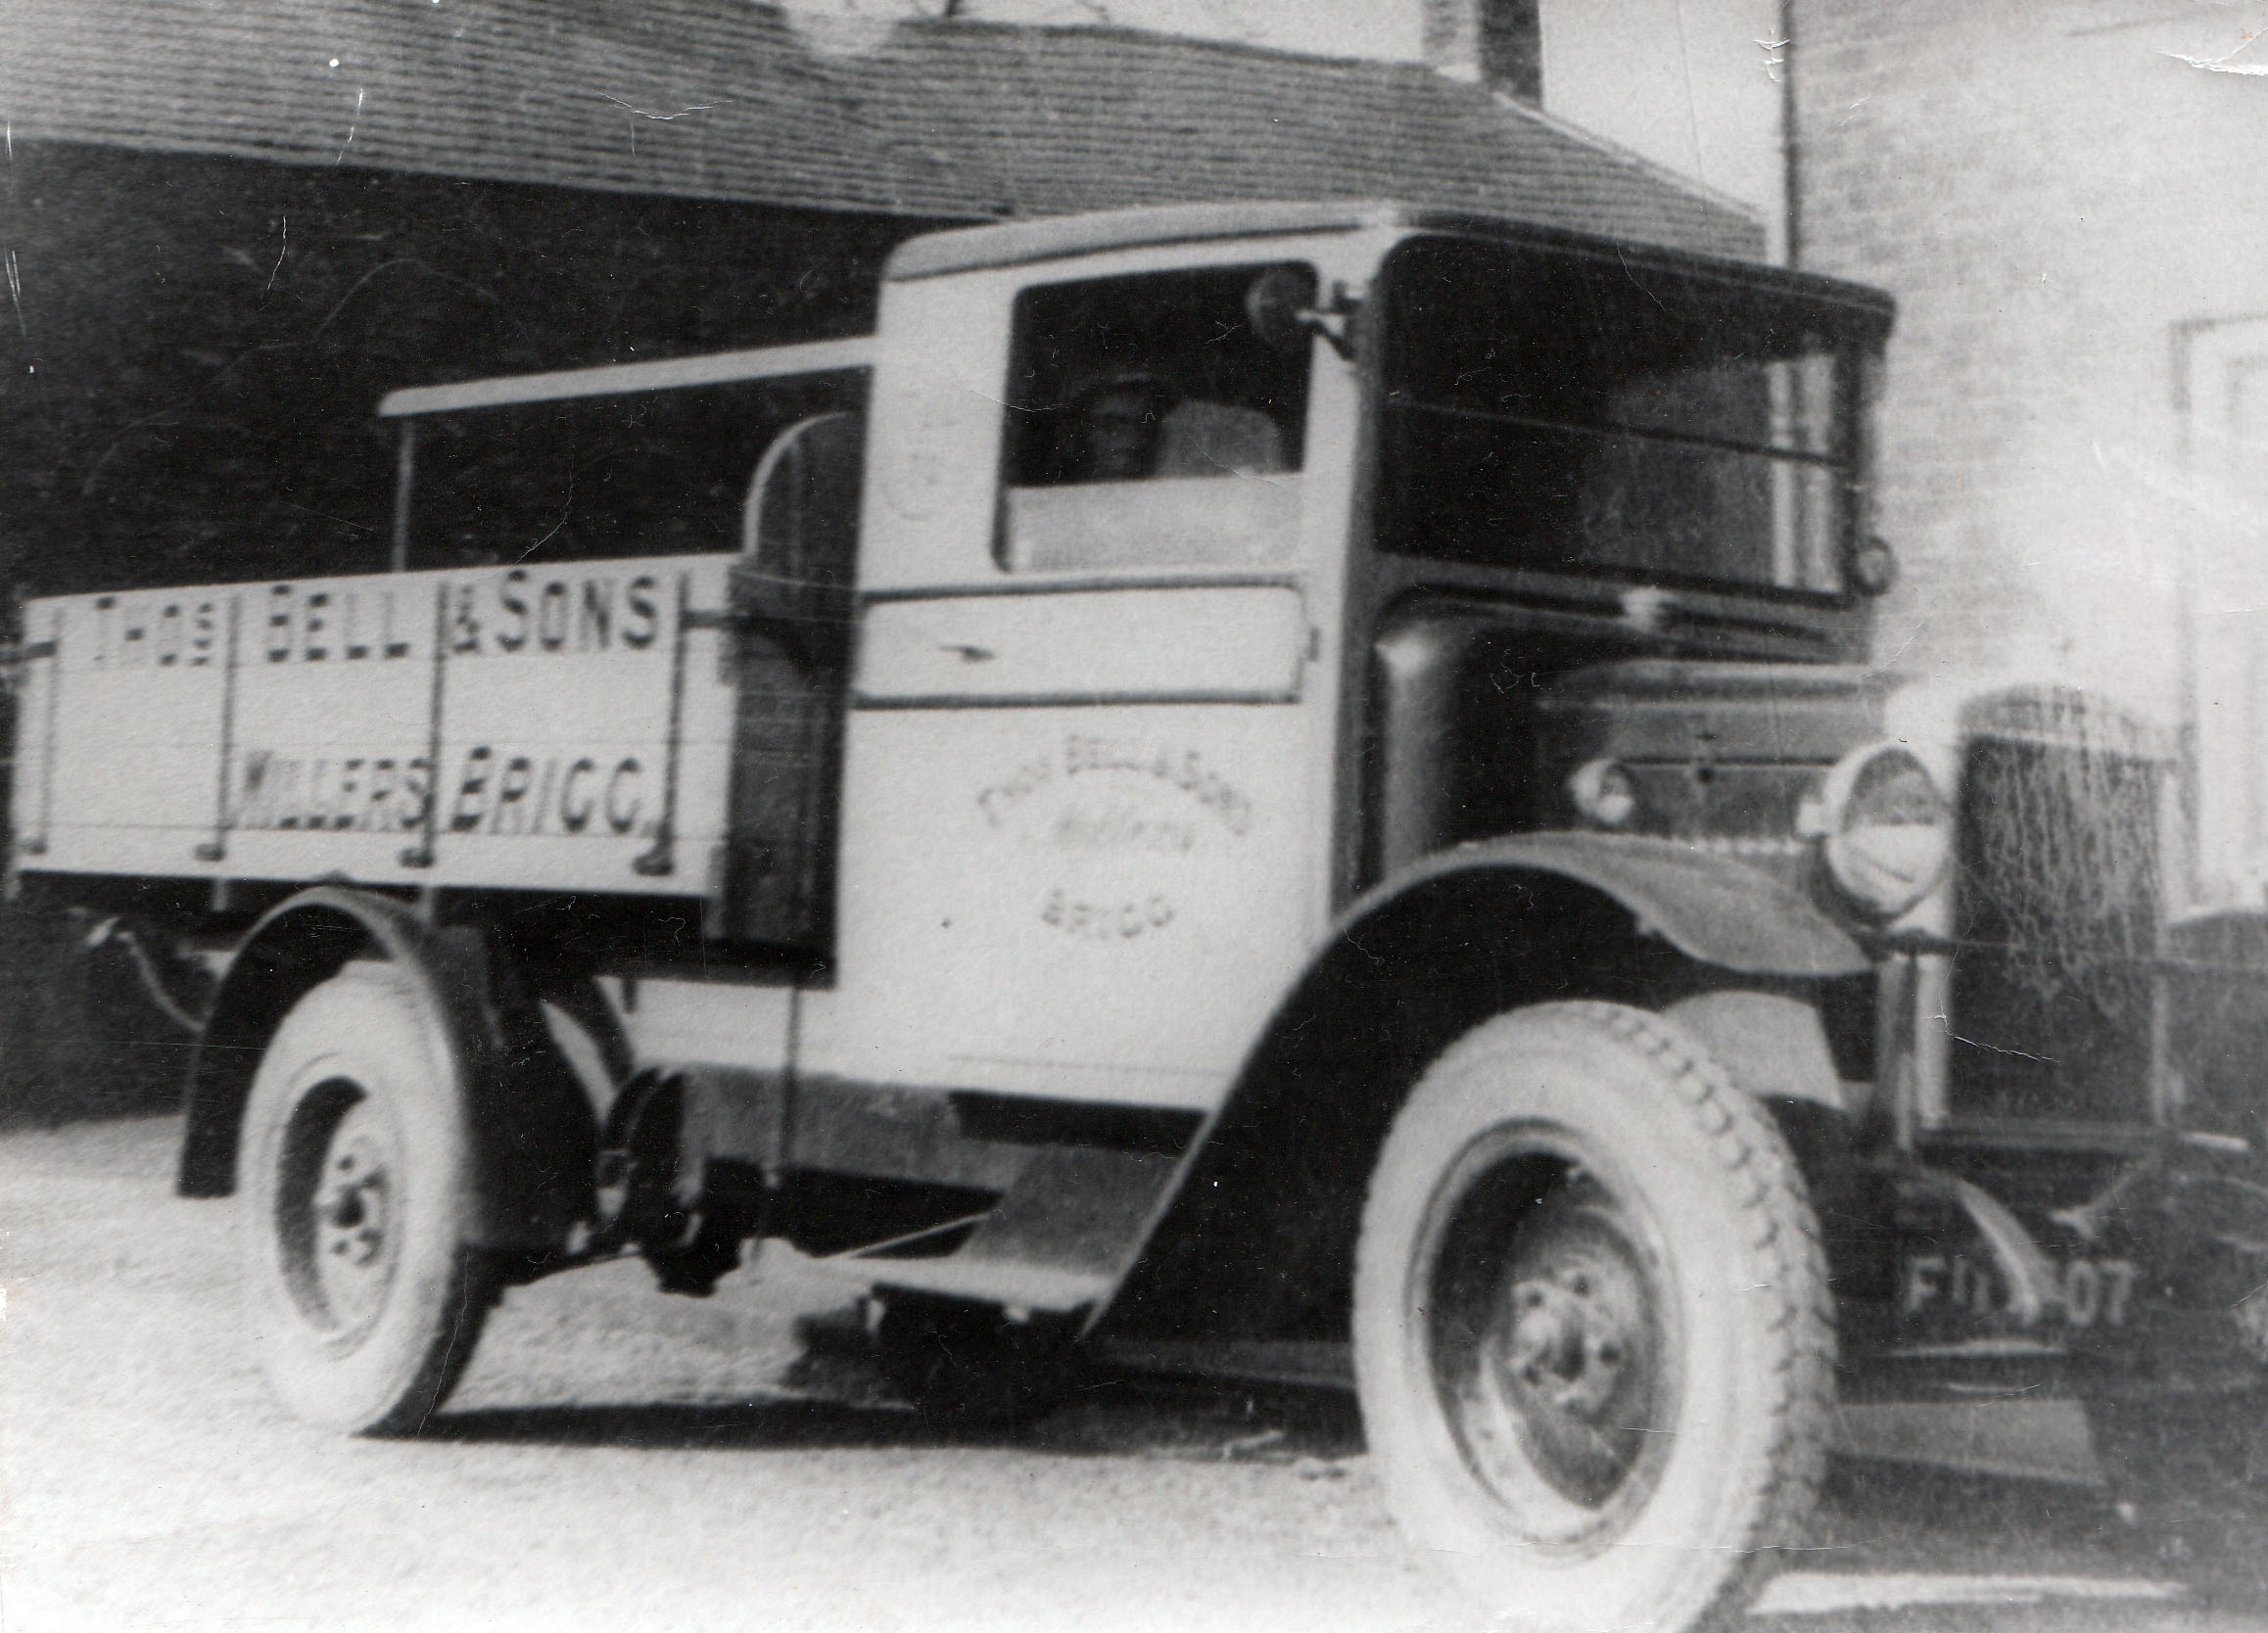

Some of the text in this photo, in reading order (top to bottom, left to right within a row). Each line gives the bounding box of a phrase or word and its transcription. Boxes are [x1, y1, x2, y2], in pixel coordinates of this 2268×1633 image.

[264, 583, 411, 665] BELL
[495, 568, 660, 653] SONS
[448, 744, 643, 834] BRIGG
